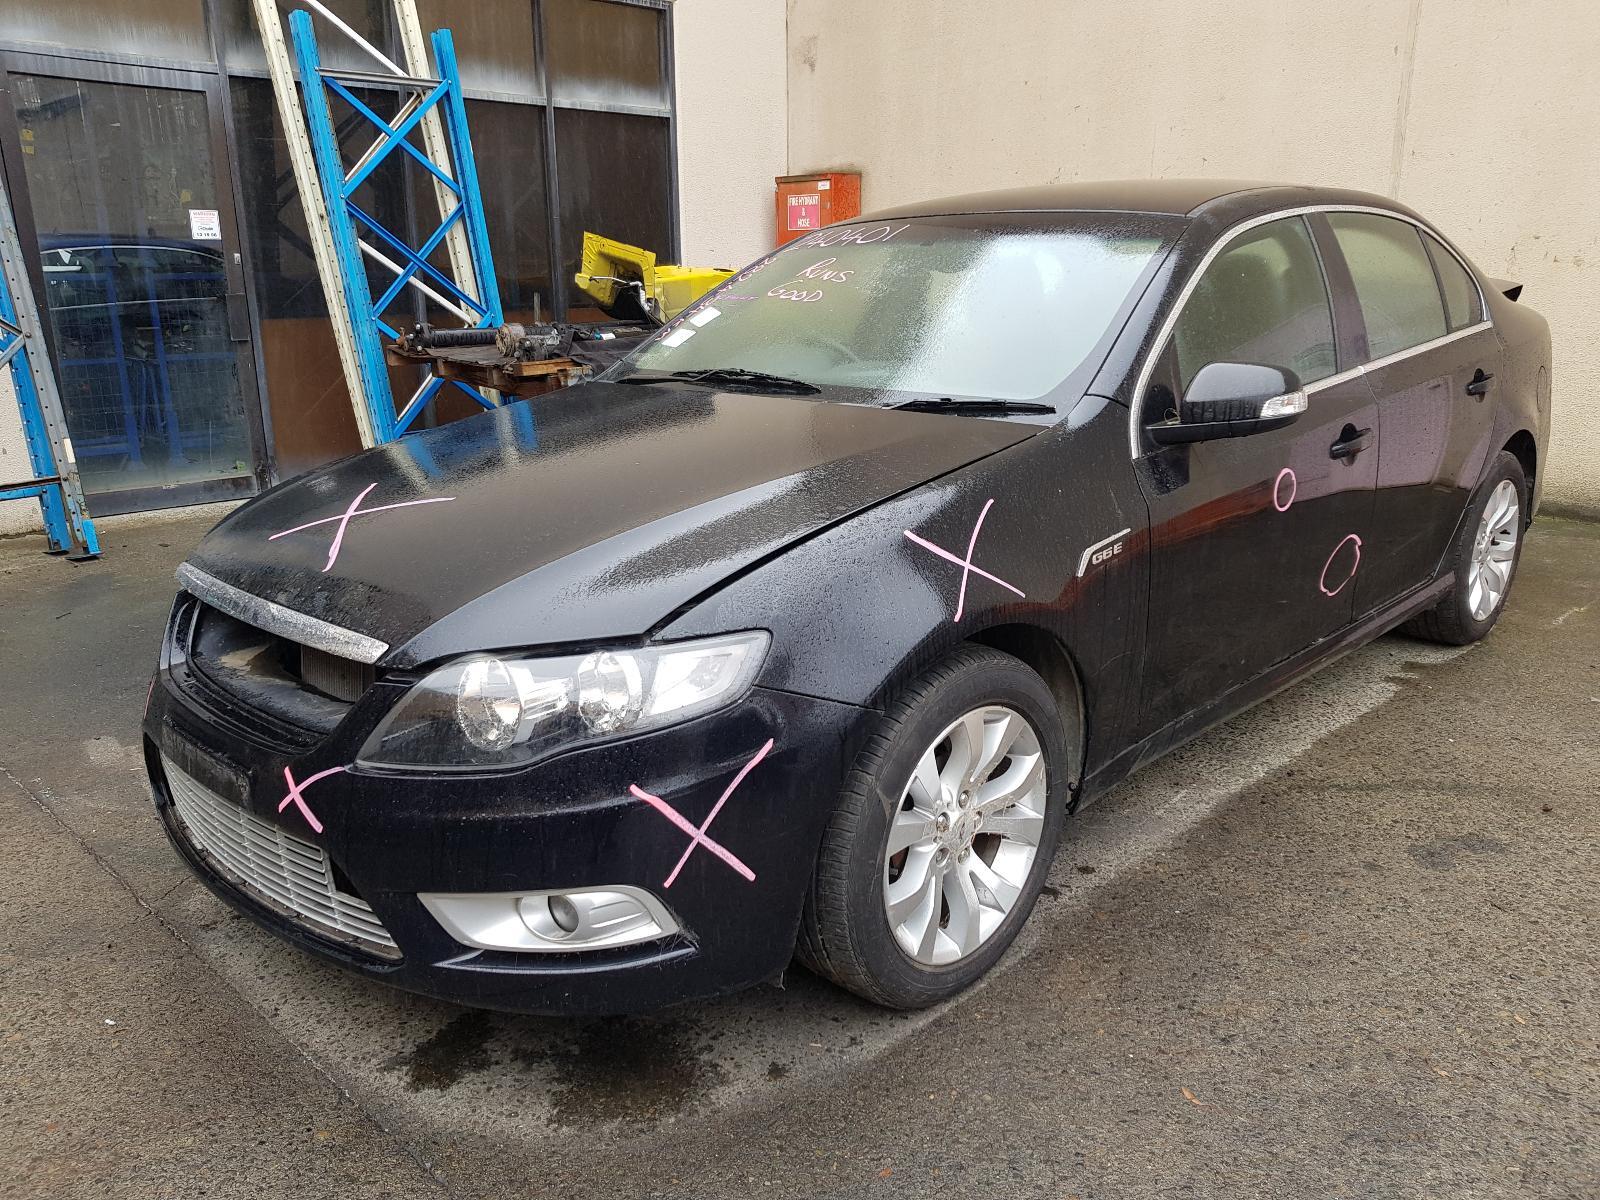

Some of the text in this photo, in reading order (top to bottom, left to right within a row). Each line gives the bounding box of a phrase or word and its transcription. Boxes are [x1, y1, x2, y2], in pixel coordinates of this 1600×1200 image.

[789, 196, 799, 206] FIRE
[797, 218, 811, 227] HOSE
[767, 279, 823, 302] GOOD
[1091, 542, 1122, 564] G6E
